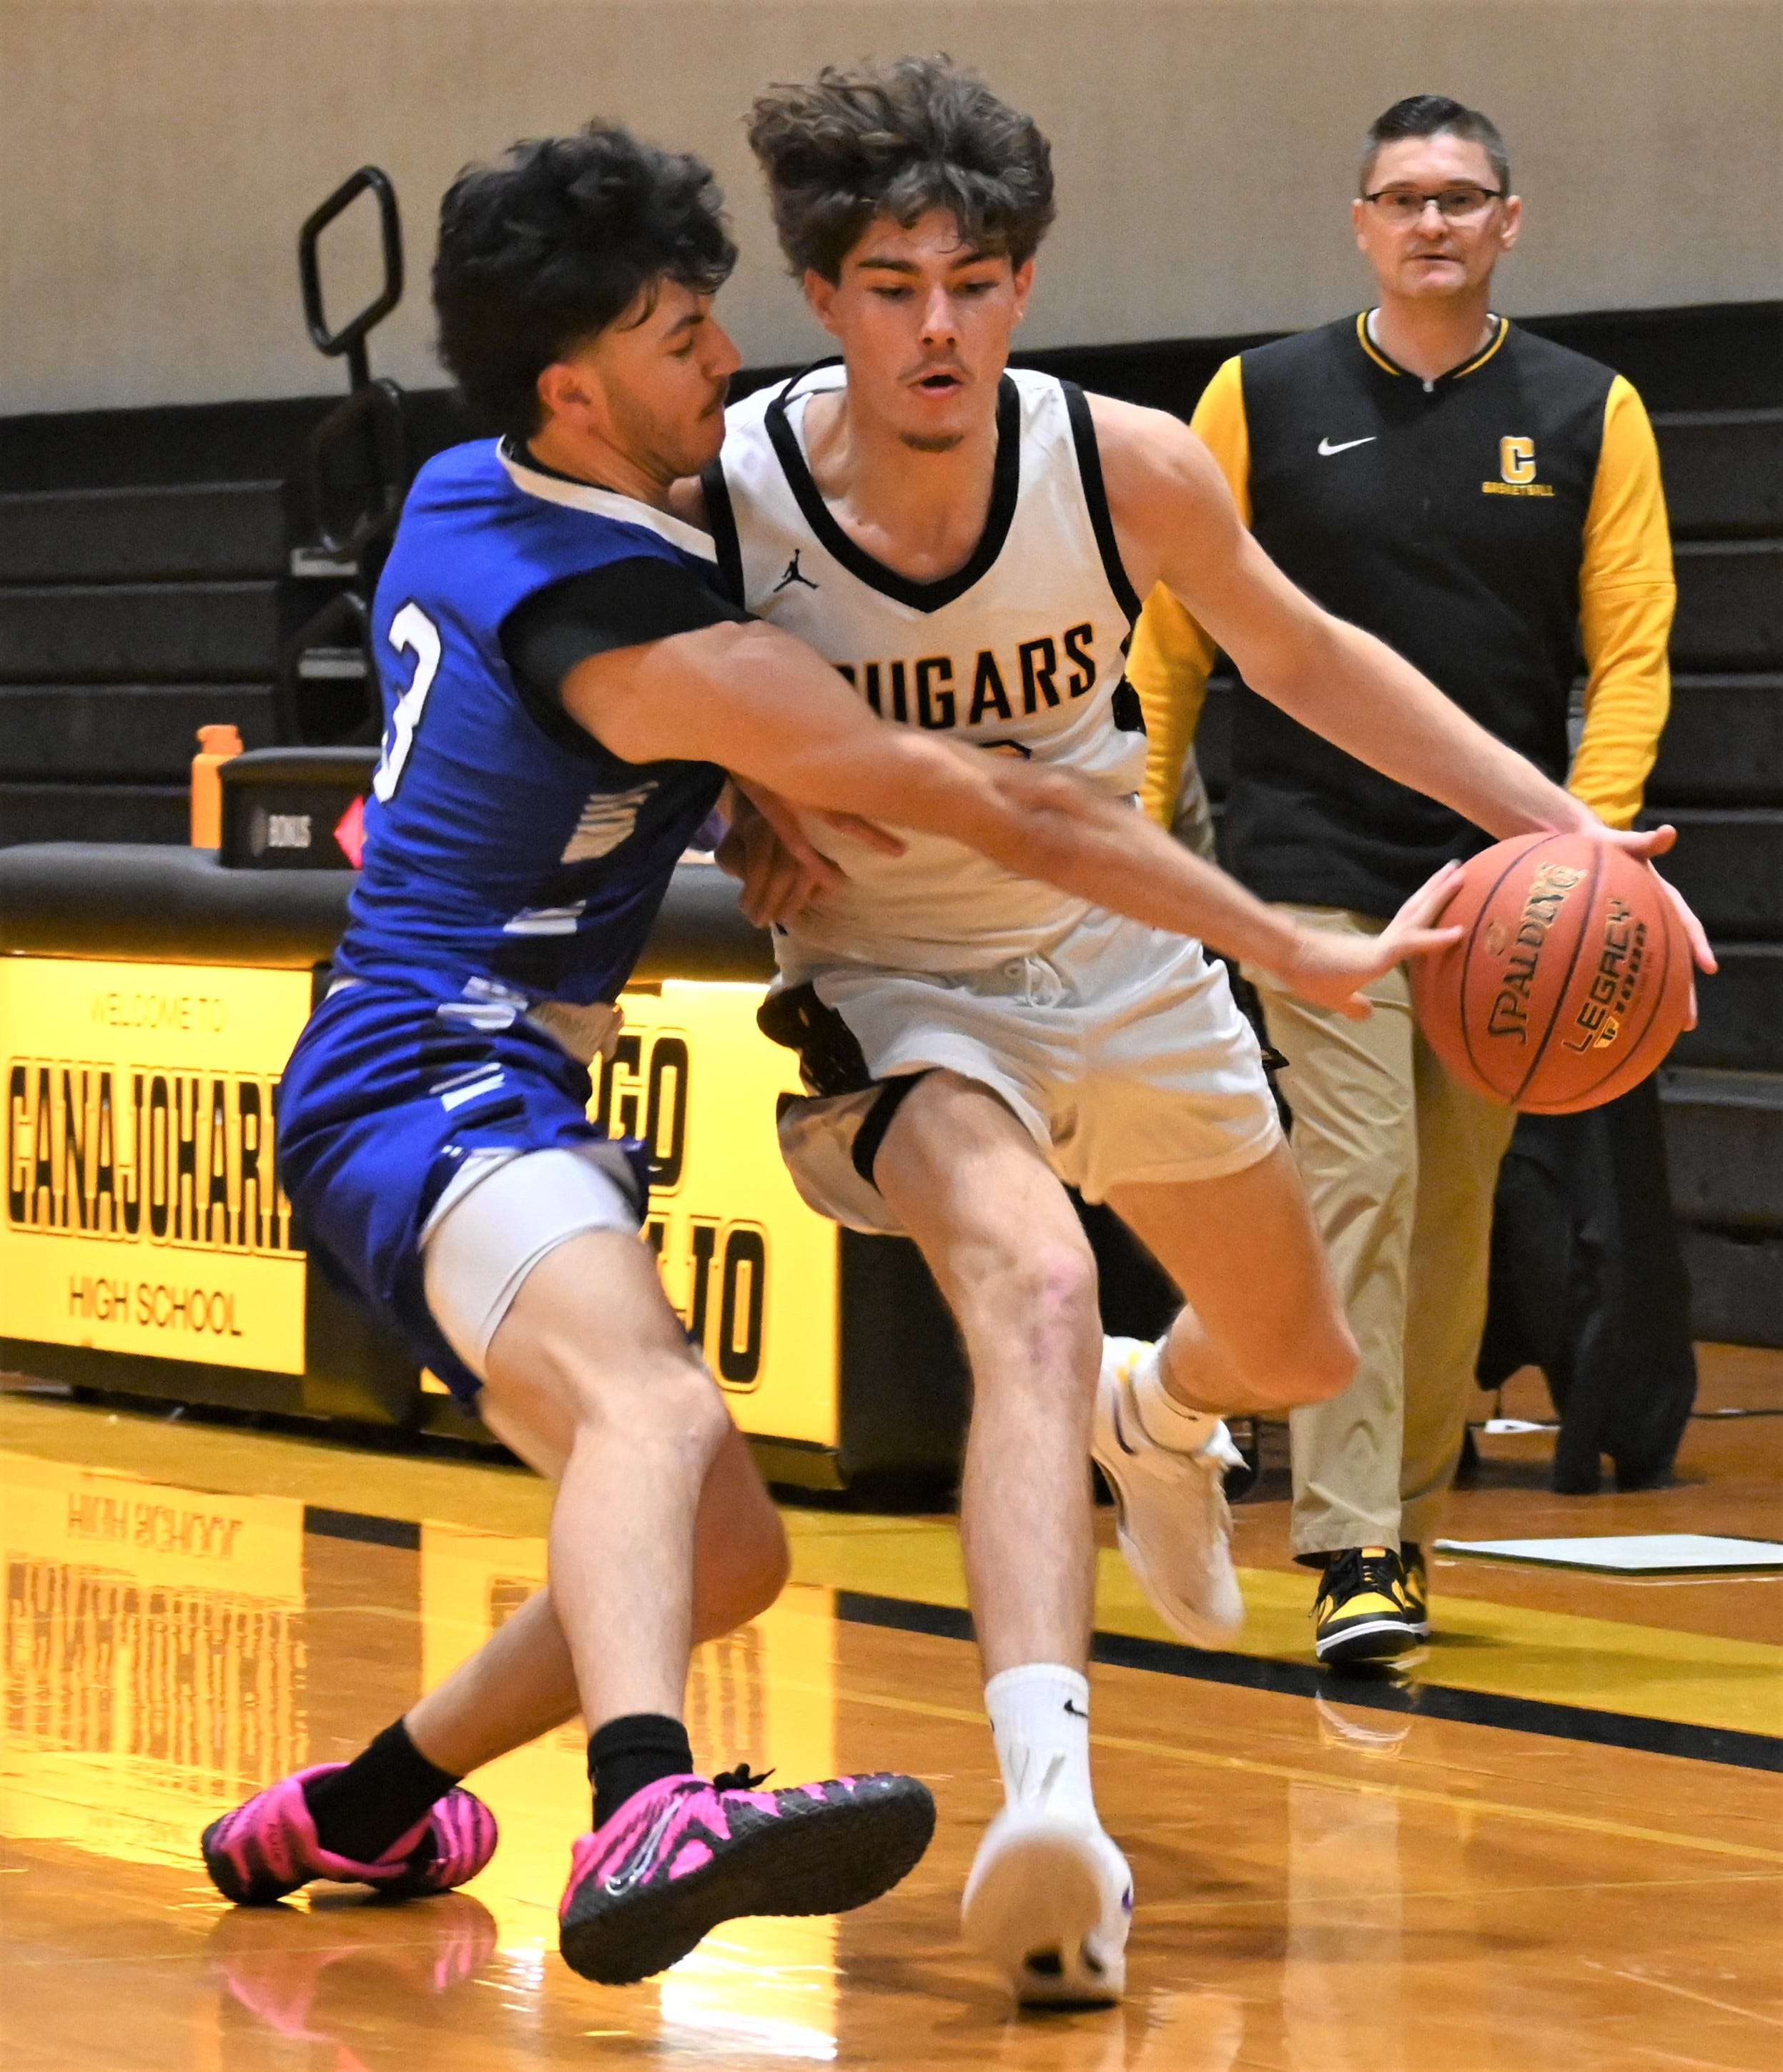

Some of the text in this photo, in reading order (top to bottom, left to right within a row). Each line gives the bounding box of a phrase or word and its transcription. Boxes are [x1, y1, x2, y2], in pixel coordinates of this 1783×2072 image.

[1500, 435, 1536, 484] C
[373, 601, 441, 804] 3
[833, 623, 1097, 730] UGARS
[89, 992, 227, 1032] WELCOME TO
[1487, 862, 1589, 1045] SPALDING
[1560, 896, 1631, 1055] LEGACY
[6, 1056, 306, 1262] CANAJOHARI
[69, 1276, 242, 1337] HIGH SCHOOL
